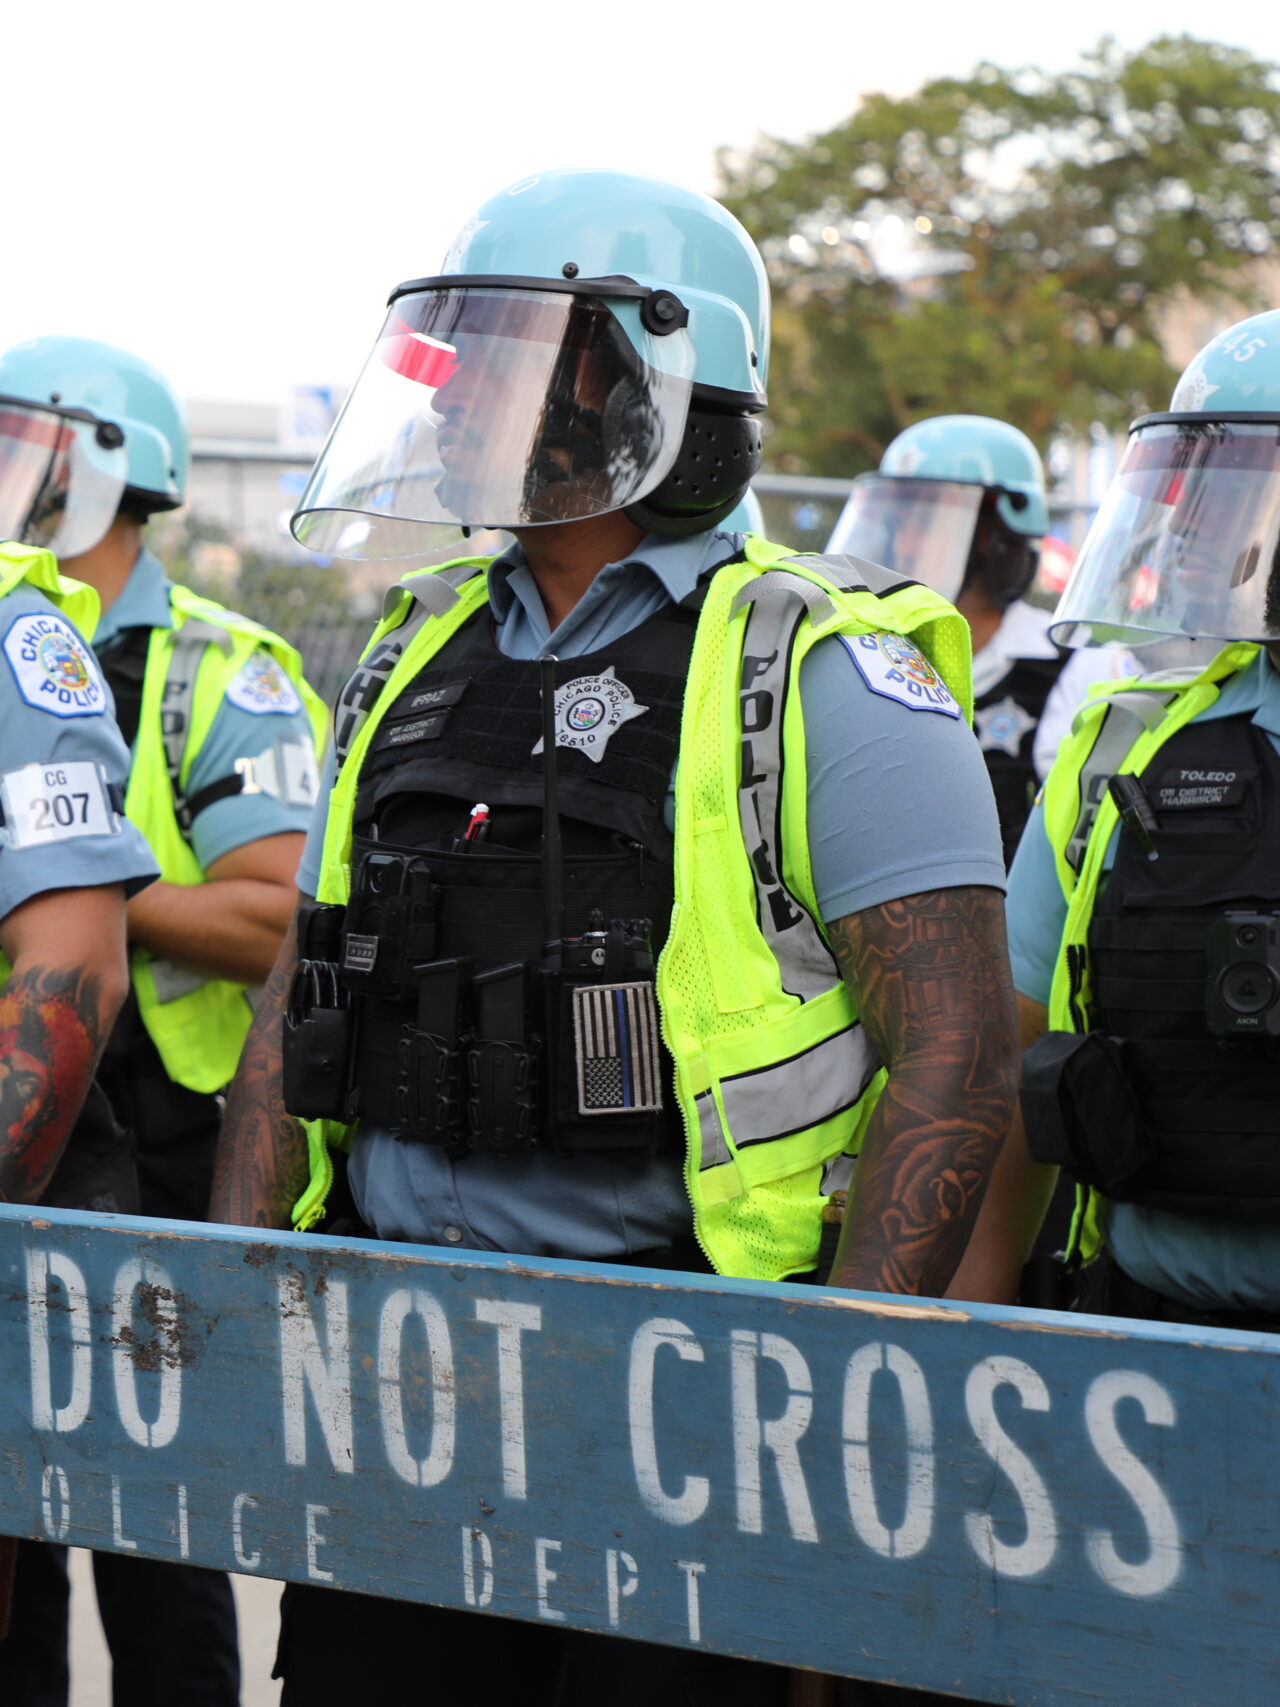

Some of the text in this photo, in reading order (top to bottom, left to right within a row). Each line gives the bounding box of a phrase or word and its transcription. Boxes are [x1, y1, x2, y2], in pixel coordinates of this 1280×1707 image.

[566, 677, 631, 701] POLICE OFFICER
[554, 685, 621, 727] CHICAGO POLICE
[44, 769, 68, 788] CG
[738, 648, 806, 933] POLICE
[1178, 785, 1230, 797] DISTRICT
[1179, 769, 1237, 783] TOLEDO
[28, 791, 90, 832] 207
[1161, 795, 1223, 806] HARRISON
[278, 1273, 543, 1500] NOT
[628, 1316, 1183, 1597] CROSS
[461, 1525, 708, 1643] DEPT
